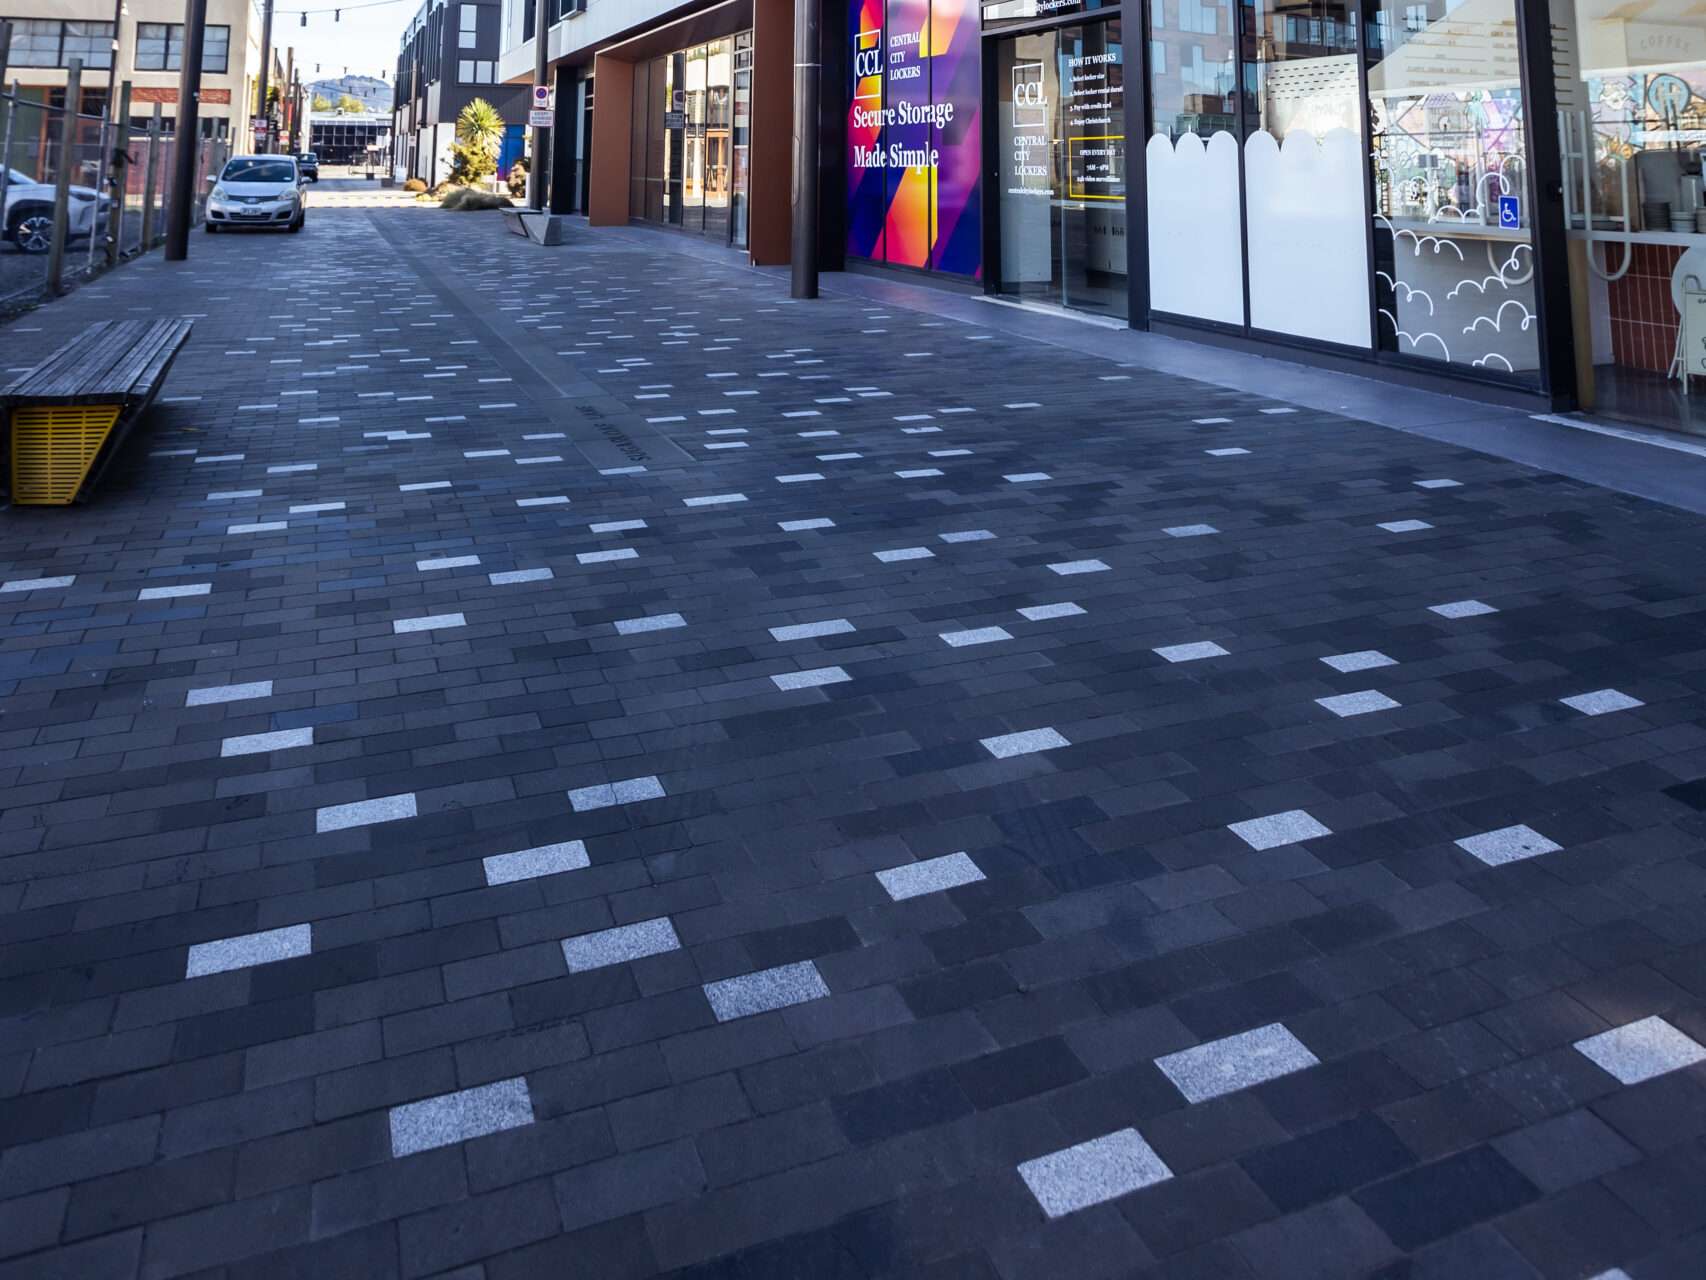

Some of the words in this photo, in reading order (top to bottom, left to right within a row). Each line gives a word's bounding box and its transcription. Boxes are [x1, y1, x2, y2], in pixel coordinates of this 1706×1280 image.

[890, 31, 920, 48] CENTRAL
[1640, 35, 1693, 53] COFFEE
[856, 49, 883, 77] CCL
[890, 51, 905, 64] CITY
[1068, 57, 1084, 67] HOW
[1085, 56, 1092, 65] IT
[1092, 53, 1117, 64] WORKS
[890, 66, 921, 80] LOCKERS
[1015, 81, 1048, 106] CCL
[854, 106, 896, 128] Secure
[898, 101, 954, 129] Storage
[1014, 135, 1047, 146] CENTRAL
[854, 143, 887, 168] Made
[889, 141, 939, 175] Simple
[1014, 150, 1031, 161] CITY
[1015, 165, 1047, 176] LOCKERS
